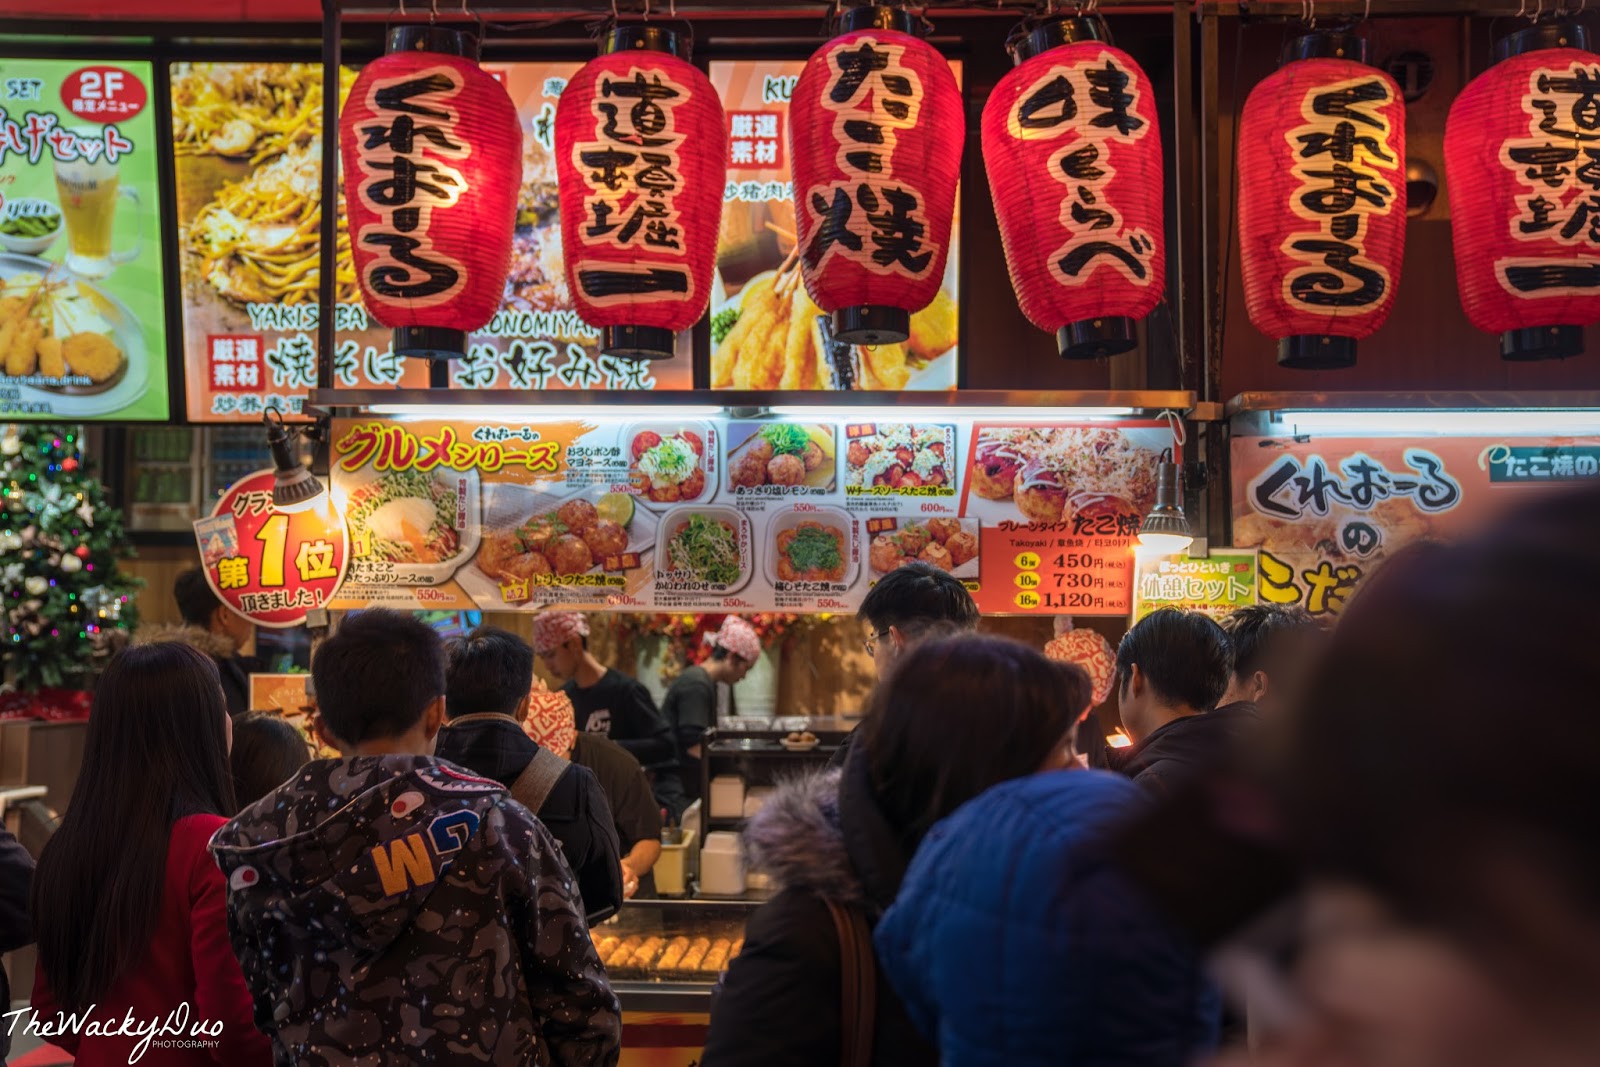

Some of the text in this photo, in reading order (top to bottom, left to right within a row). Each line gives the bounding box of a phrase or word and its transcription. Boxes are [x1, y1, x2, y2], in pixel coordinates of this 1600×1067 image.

[7, 79, 42, 99] SET
[79, 71, 125, 98] 2F
[764, 76, 796, 104] KU
[0, 110, 133, 164] げセット
[802, 43, 933, 273] たこ焼
[248, 304, 367, 331] YAKISBA
[1505, 455, 1600, 477] たこ焼の
[1250, 449, 1460, 517] くれおーる
